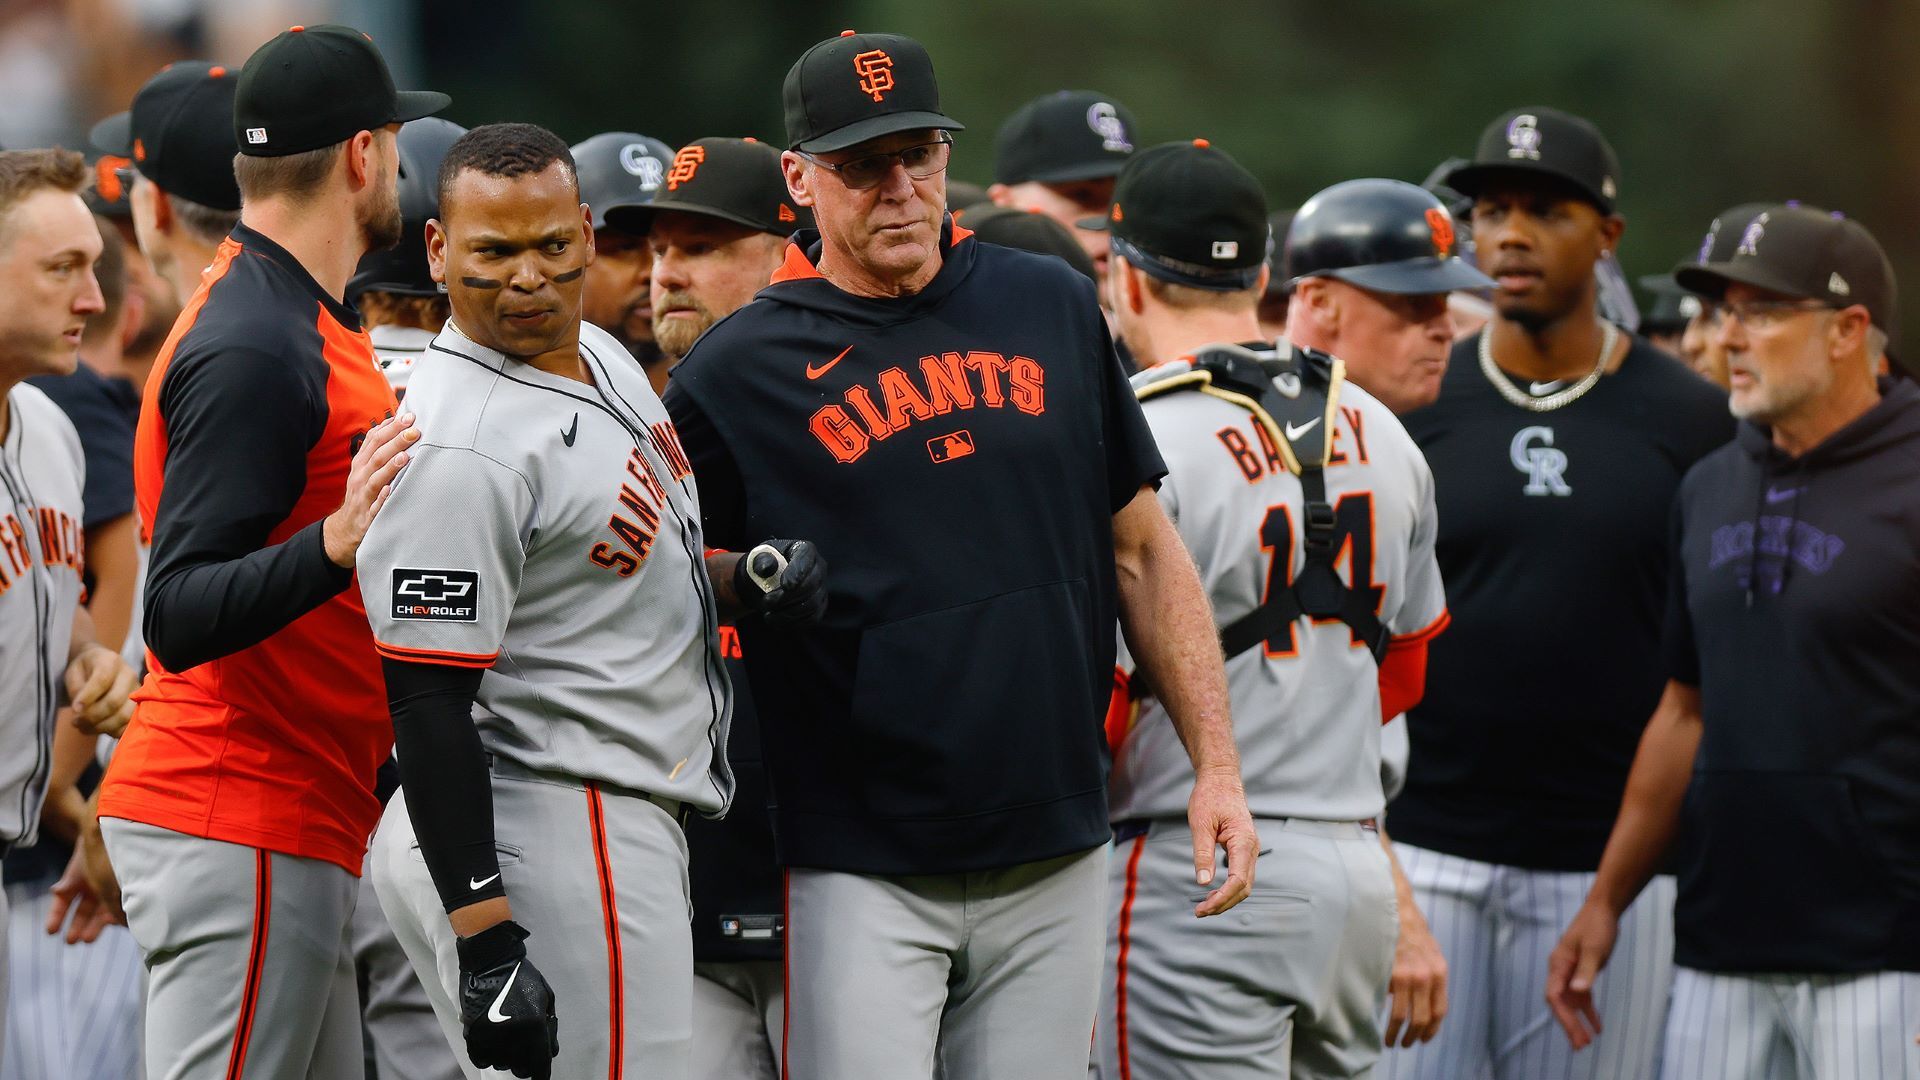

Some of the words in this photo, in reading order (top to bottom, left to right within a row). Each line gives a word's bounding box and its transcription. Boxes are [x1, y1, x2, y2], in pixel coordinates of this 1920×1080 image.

[853, 48, 894, 102] SF
[808, 351, 1044, 463] GIANTS
[1216, 405, 1370, 484] BAEY
[1509, 425, 1573, 496] CR
[589, 482, 661, 578] SAN
[1708, 515, 1846, 577] ROKES
[397, 605, 472, 616] CHEVROLET
[1259, 491, 1387, 660] 14
